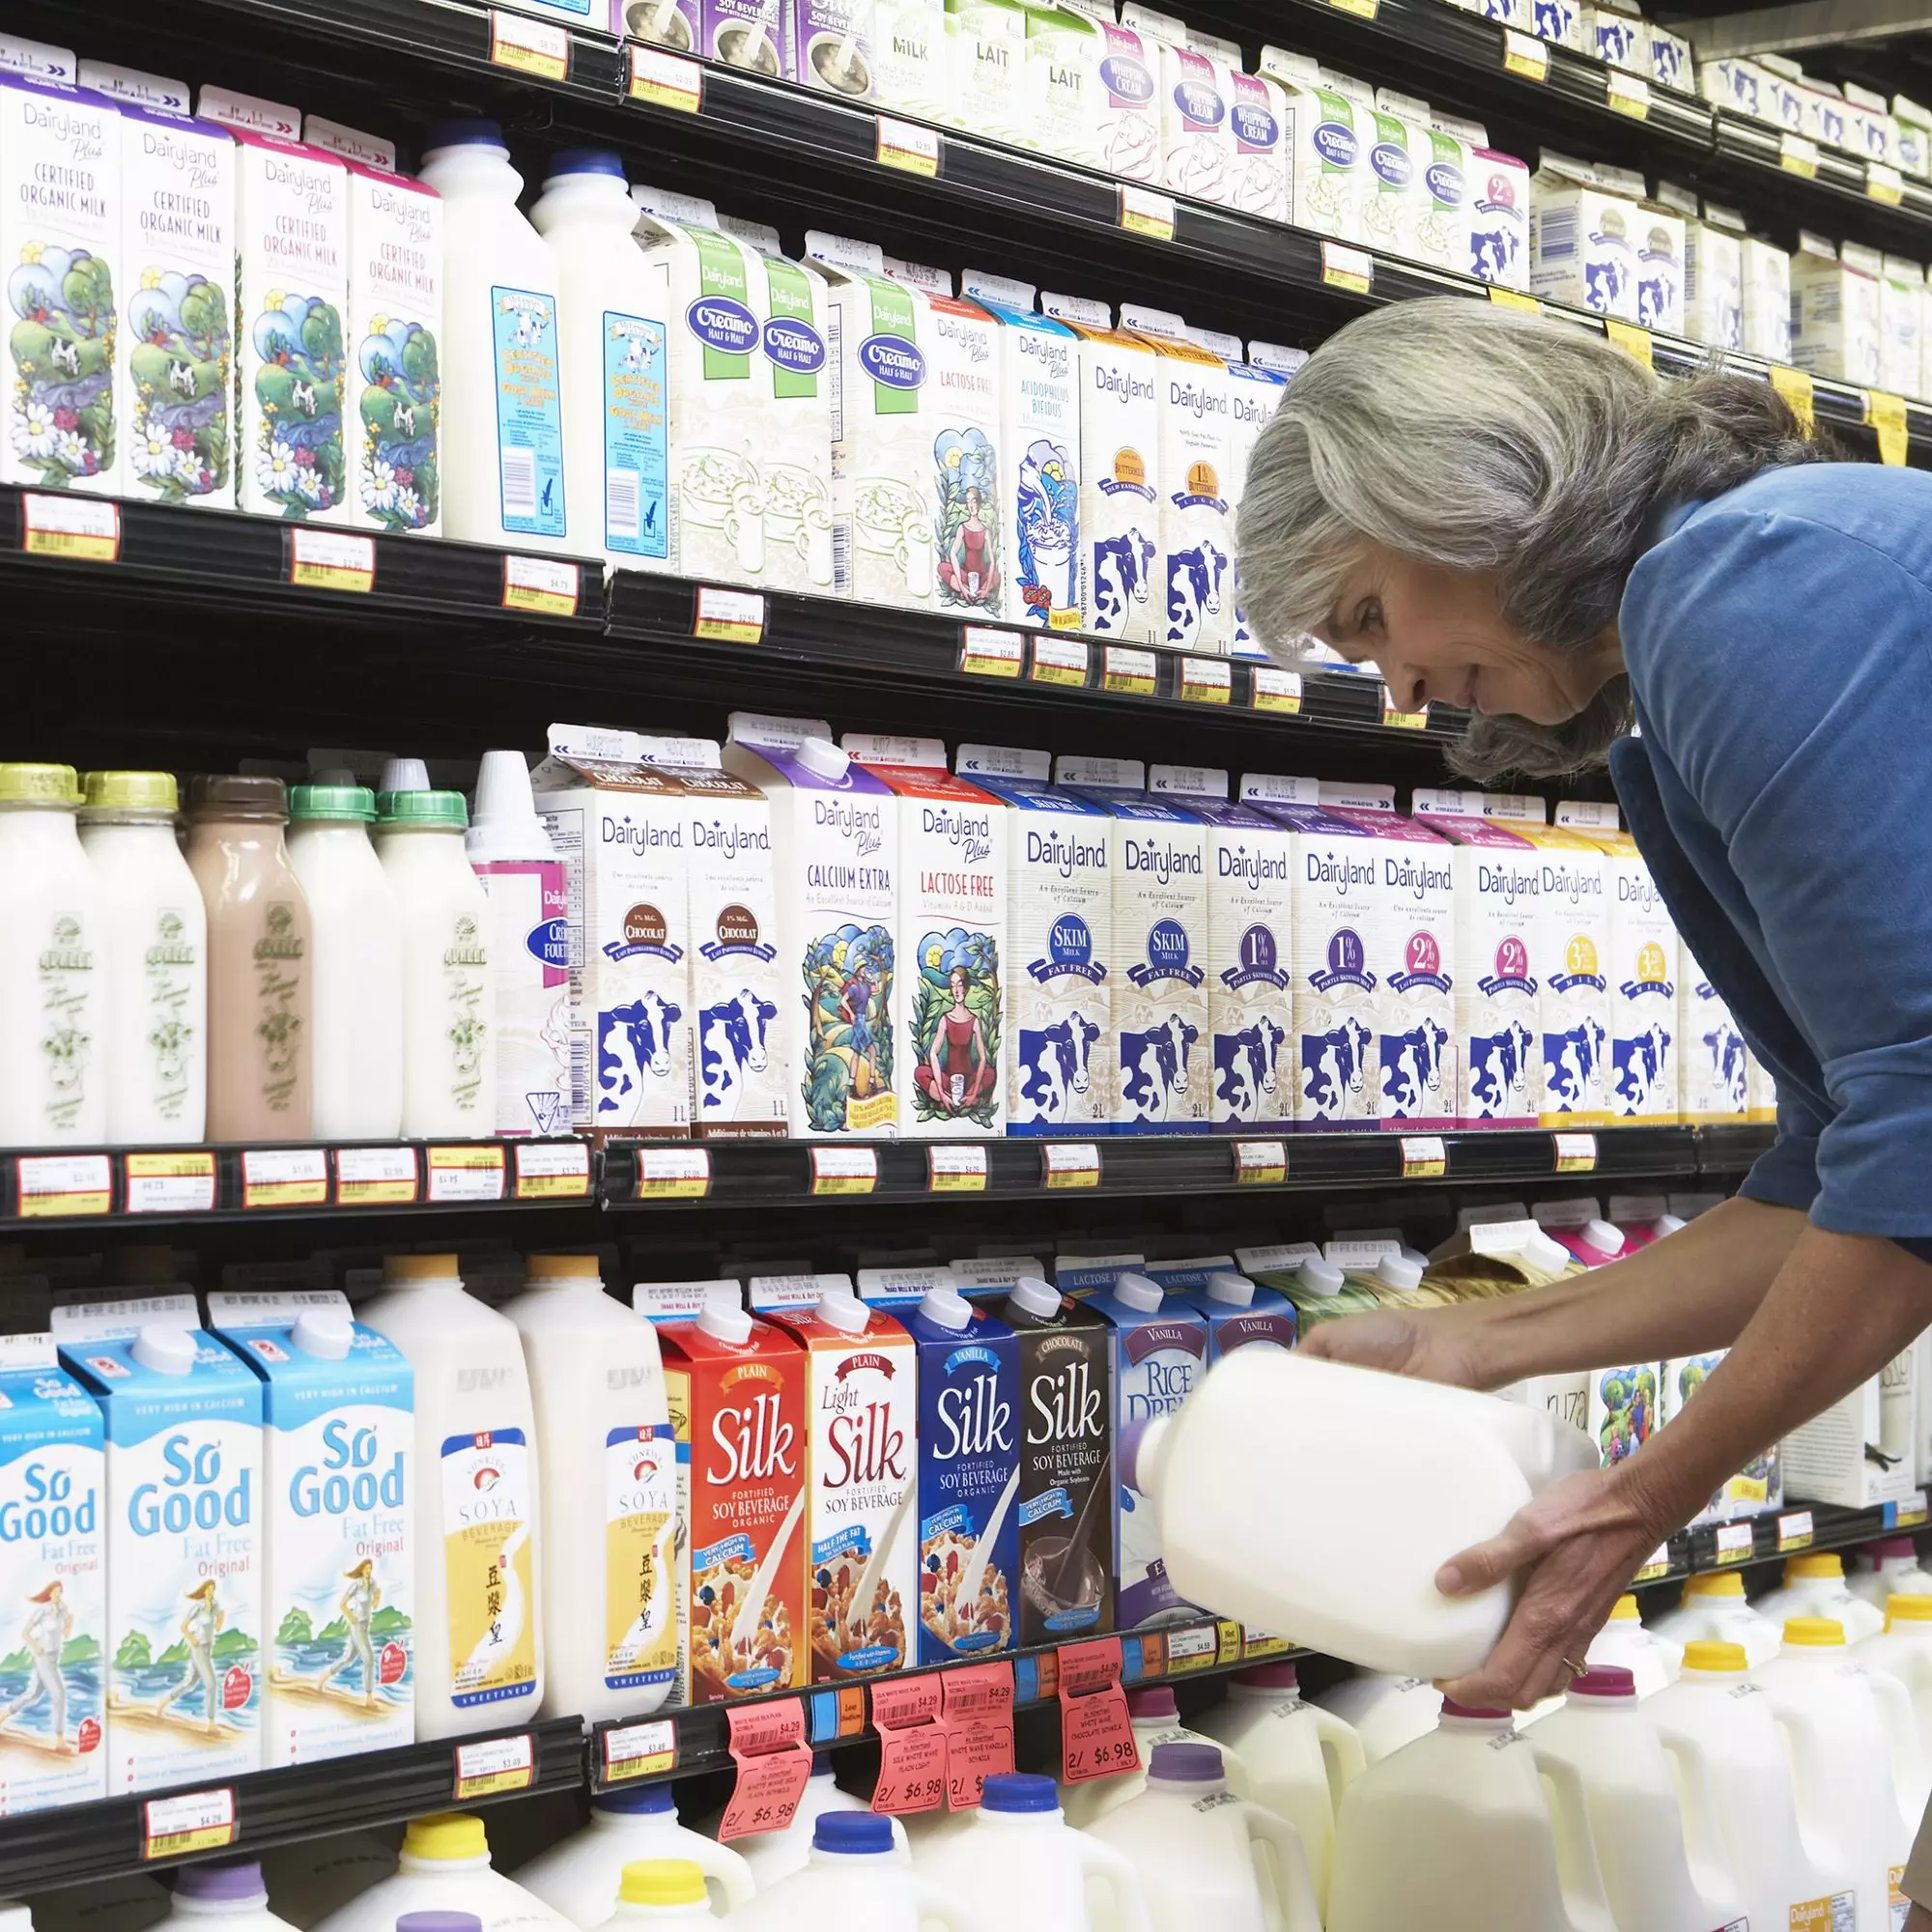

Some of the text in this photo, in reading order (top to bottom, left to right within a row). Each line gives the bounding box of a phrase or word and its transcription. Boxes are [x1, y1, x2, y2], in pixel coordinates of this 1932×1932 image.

[977, 42, 1009, 67] LAIT
[1049, 66, 1081, 90] LAIT
[23, 101, 101, 142] Dairyland
[143, 132, 217, 170] Dairyland
[34, 162, 95, 192] CERTIFIED
[265, 159, 331, 196] Dairyland
[20, 184, 106, 218] ORGANIC MILK
[153, 190, 211, 219] CERTIFIED
[371, 188, 430, 225] Dairyland
[140, 211, 222, 244] ORGANIC MILK
[275, 214, 327, 242] CERTIFIED
[264, 235, 337, 267] ORGANIC MILK
[380, 242, 425, 270] CERTIFIED
[369, 261, 434, 294] ORGANIC MILK
[696, 306, 753, 335] Creamo
[708, 328, 724, 341] HALF
[730, 333, 744, 345] HALF
[766, 327, 819, 355] Creamo
[937, 319, 987, 348] Dairyland
[778, 349, 792, 359] HALF
[798, 353, 811, 364] HALF
[868, 345, 922, 372] Creamo
[1019, 335, 1067, 364] Dairyland
[879, 365, 894, 376] HALF
[899, 370, 913, 381] HALF
[940, 371, 975, 394] LACTOSE
[1095, 365, 1155, 404] Dairyland
[1171, 382, 1228, 418] Dairyland
[1115, 462, 1145, 478] BUTTERMILK
[815, 799, 880, 838] Dairyland
[923, 809, 988, 845] Dairyland
[602, 816, 681, 857] Dairyland
[693, 820, 769, 859] Dairyland
[1028, 830, 1106, 878] Dairyland
[1125, 838, 1203, 886] Dairyland
[808, 865, 892, 892] CALCIUM EXTRA
[1218, 845, 1287, 891] Dairyland
[1308, 852, 1376, 895] Dairyland
[1385, 857, 1451, 900] Dairyland
[921, 871, 994, 896] LACTOSE FREE
[1479, 865, 1538, 905] Dairyland
[1543, 866, 1602, 904] Dairyland
[625, 924, 665, 940] CHOCOLAT
[719, 925, 757, 940] CHOCOLAT
[1054, 925, 1088, 948] SKIM
[1152, 929, 1184, 952] SKIM
[1412, 937, 1435, 970] 2%
[1502, 941, 1523, 974] 2%
[1048, 964, 1094, 979] FAT FREE
[1148, 968, 1192, 981] FAT FREE
[1233, 975, 1251, 987] PARTLY
[1566, 978, 1600, 988] MILK
[1093, 1103, 1104, 1119] 2L
[1192, 1103, 1205, 1118] 2L
[1279, 1102, 1290, 1117] 2L
[738, 1128, 747, 1138] de
[748, 1128, 770, 1139] vitamines
[1148, 1327, 1182, 1341] VANILLA
[1239, 1319, 1273, 1332] VANILLA
[955, 1349, 988, 1362] VANILLA
[1041, 1338, 1084, 1353] CHOCOLATE
[737, 1364, 767, 1378] PLAIN
[852, 1355, 880, 1369] PLAIN
[294, 1383, 398, 1401] VERY HIGH IN CALCIUM
[1146, 1361, 1192, 1398] RICE
[821, 1382, 860, 1414] Light
[1027, 1362, 1105, 1444] Silk
[933, 1375, 1014, 1460] Silk
[322, 1419, 378, 1469] So
[706, 1393, 797, 1486] Silk
[823, 1402, 906, 1490] Silk
[1051, 1442, 1088, 1453] FORTIFIED
[163, 1434, 222, 1487] So
[956, 1461, 995, 1472] FORTIFIED
[1033, 1450, 1101, 1471] SOY BEVERAGE
[24, 1463, 71, 1503] So
[290, 1451, 405, 1517] Good
[846, 1485, 887, 1496] FORTIFIED
[940, 1467, 1009, 1490] SOY BEVERAGE
[128, 1466, 251, 1537] Good
[619, 1489, 669, 1515] SOYA
[732, 1487, 775, 1499] FORTIFIED
[825, 1492, 903, 1514] SOY BEVERAGE
[957, 1486, 996, 1497] ORGANIC
[0, 1489, 95, 1542] Good
[459, 1498, 517, 1526] SOYA
[712, 1494, 790, 1520] SOY BEVERAGE
[1027, 1497, 1062, 1520] CALCIUM
[732, 1515, 775, 1528] ORGANIC
[928, 1515, 963, 1535] CALCIUM
[42, 1540, 97, 1561] Fat Free
[184, 1534, 251, 1558] Fat Free
[355, 1536, 404, 1556] Original
[703, 1546, 721, 1558] VERY
[721, 1540, 737, 1550] HIGH
[704, 1544, 745, 1566] CALCIUM
[55, 1559, 98, 1577] Original
[198, 1557, 250, 1577] Original
[613, 1671, 671, 1688] SWEETENED
[1101, 1662, 1119, 1673] $4.29
[463, 1685, 528, 1705] SWEETENED
[918, 1695, 938, 1708] $4.29
[989, 1687, 1009, 1698] $4.29
[780, 1721, 801, 1736] $4.29
[951, 1742, 1009, 1755] WHITE WAVE VANILLA
[968, 1754, 991, 1764] SOYMILK
[1068, 1742, 1133, 1768] 2/ $6.98
[877, 1778, 942, 1803] 2/ $6.98
[725, 1802, 795, 1828] 2/ $6.98
